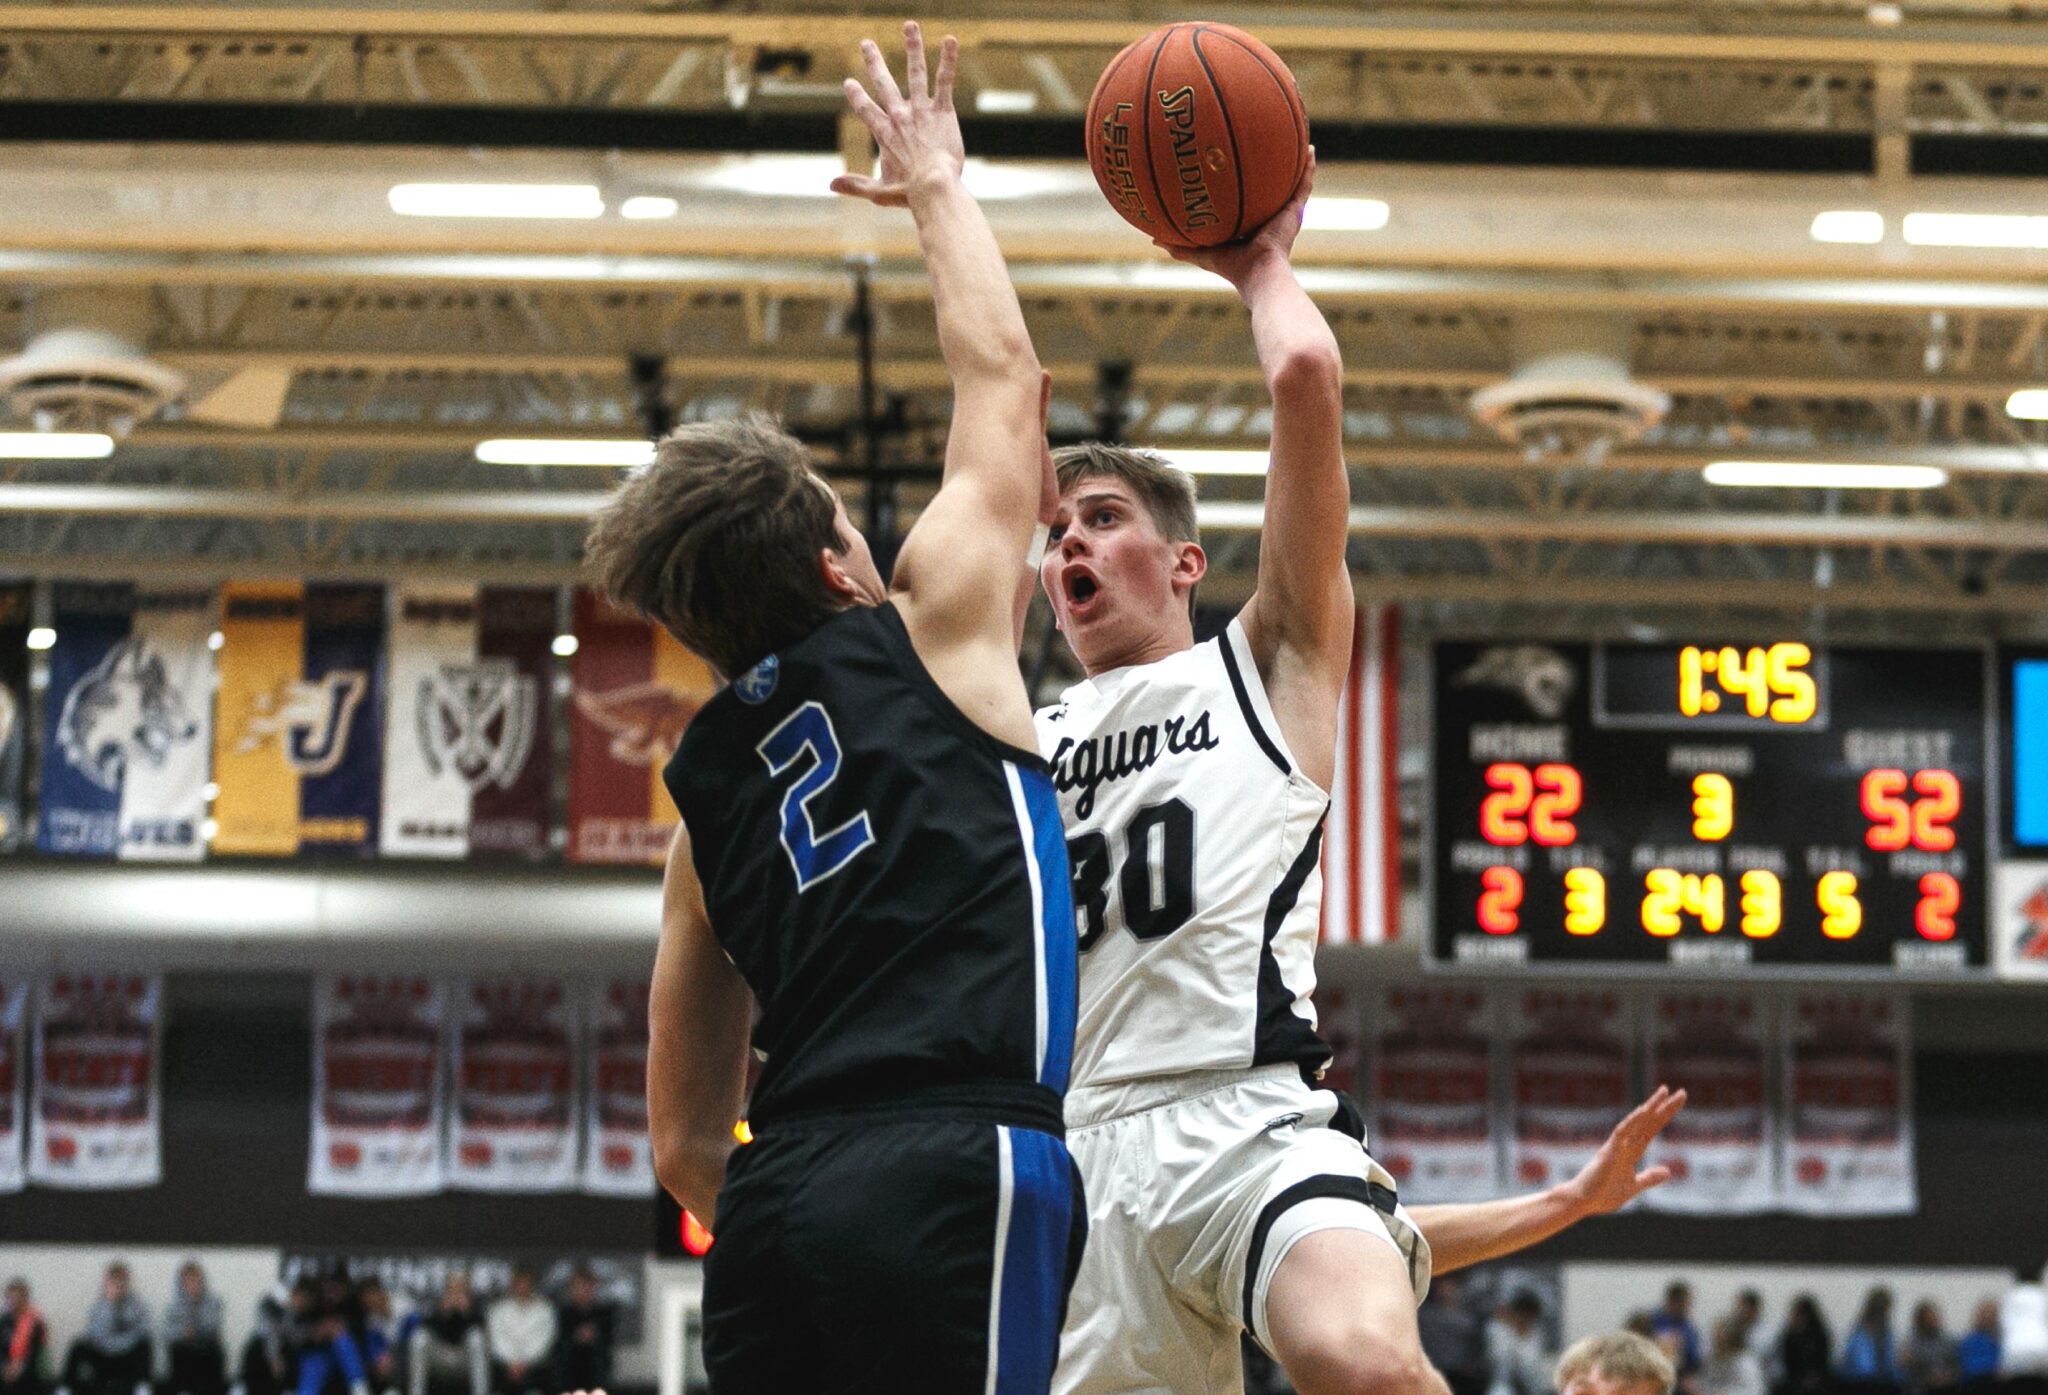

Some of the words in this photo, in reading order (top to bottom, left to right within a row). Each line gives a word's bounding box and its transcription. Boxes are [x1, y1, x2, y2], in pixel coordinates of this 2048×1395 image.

[1112, 103, 1155, 223] LEGACY
[1157, 86, 1220, 231] SPALDING
[1679, 643, 1817, 724] 1:45
[755, 700, 876, 894] 2
[1480, 762, 1582, 846] 22
[1691, 773, 1734, 840] 3
[1859, 768, 1961, 852] 52
[1477, 865, 1524, 935] 2
[1564, 867, 1606, 936] 3
[1641, 867, 1725, 937] 24
[1740, 869, 1782, 938] 3
[1816, 870, 1862, 939] 5
[1915, 871, 1960, 941] 2
